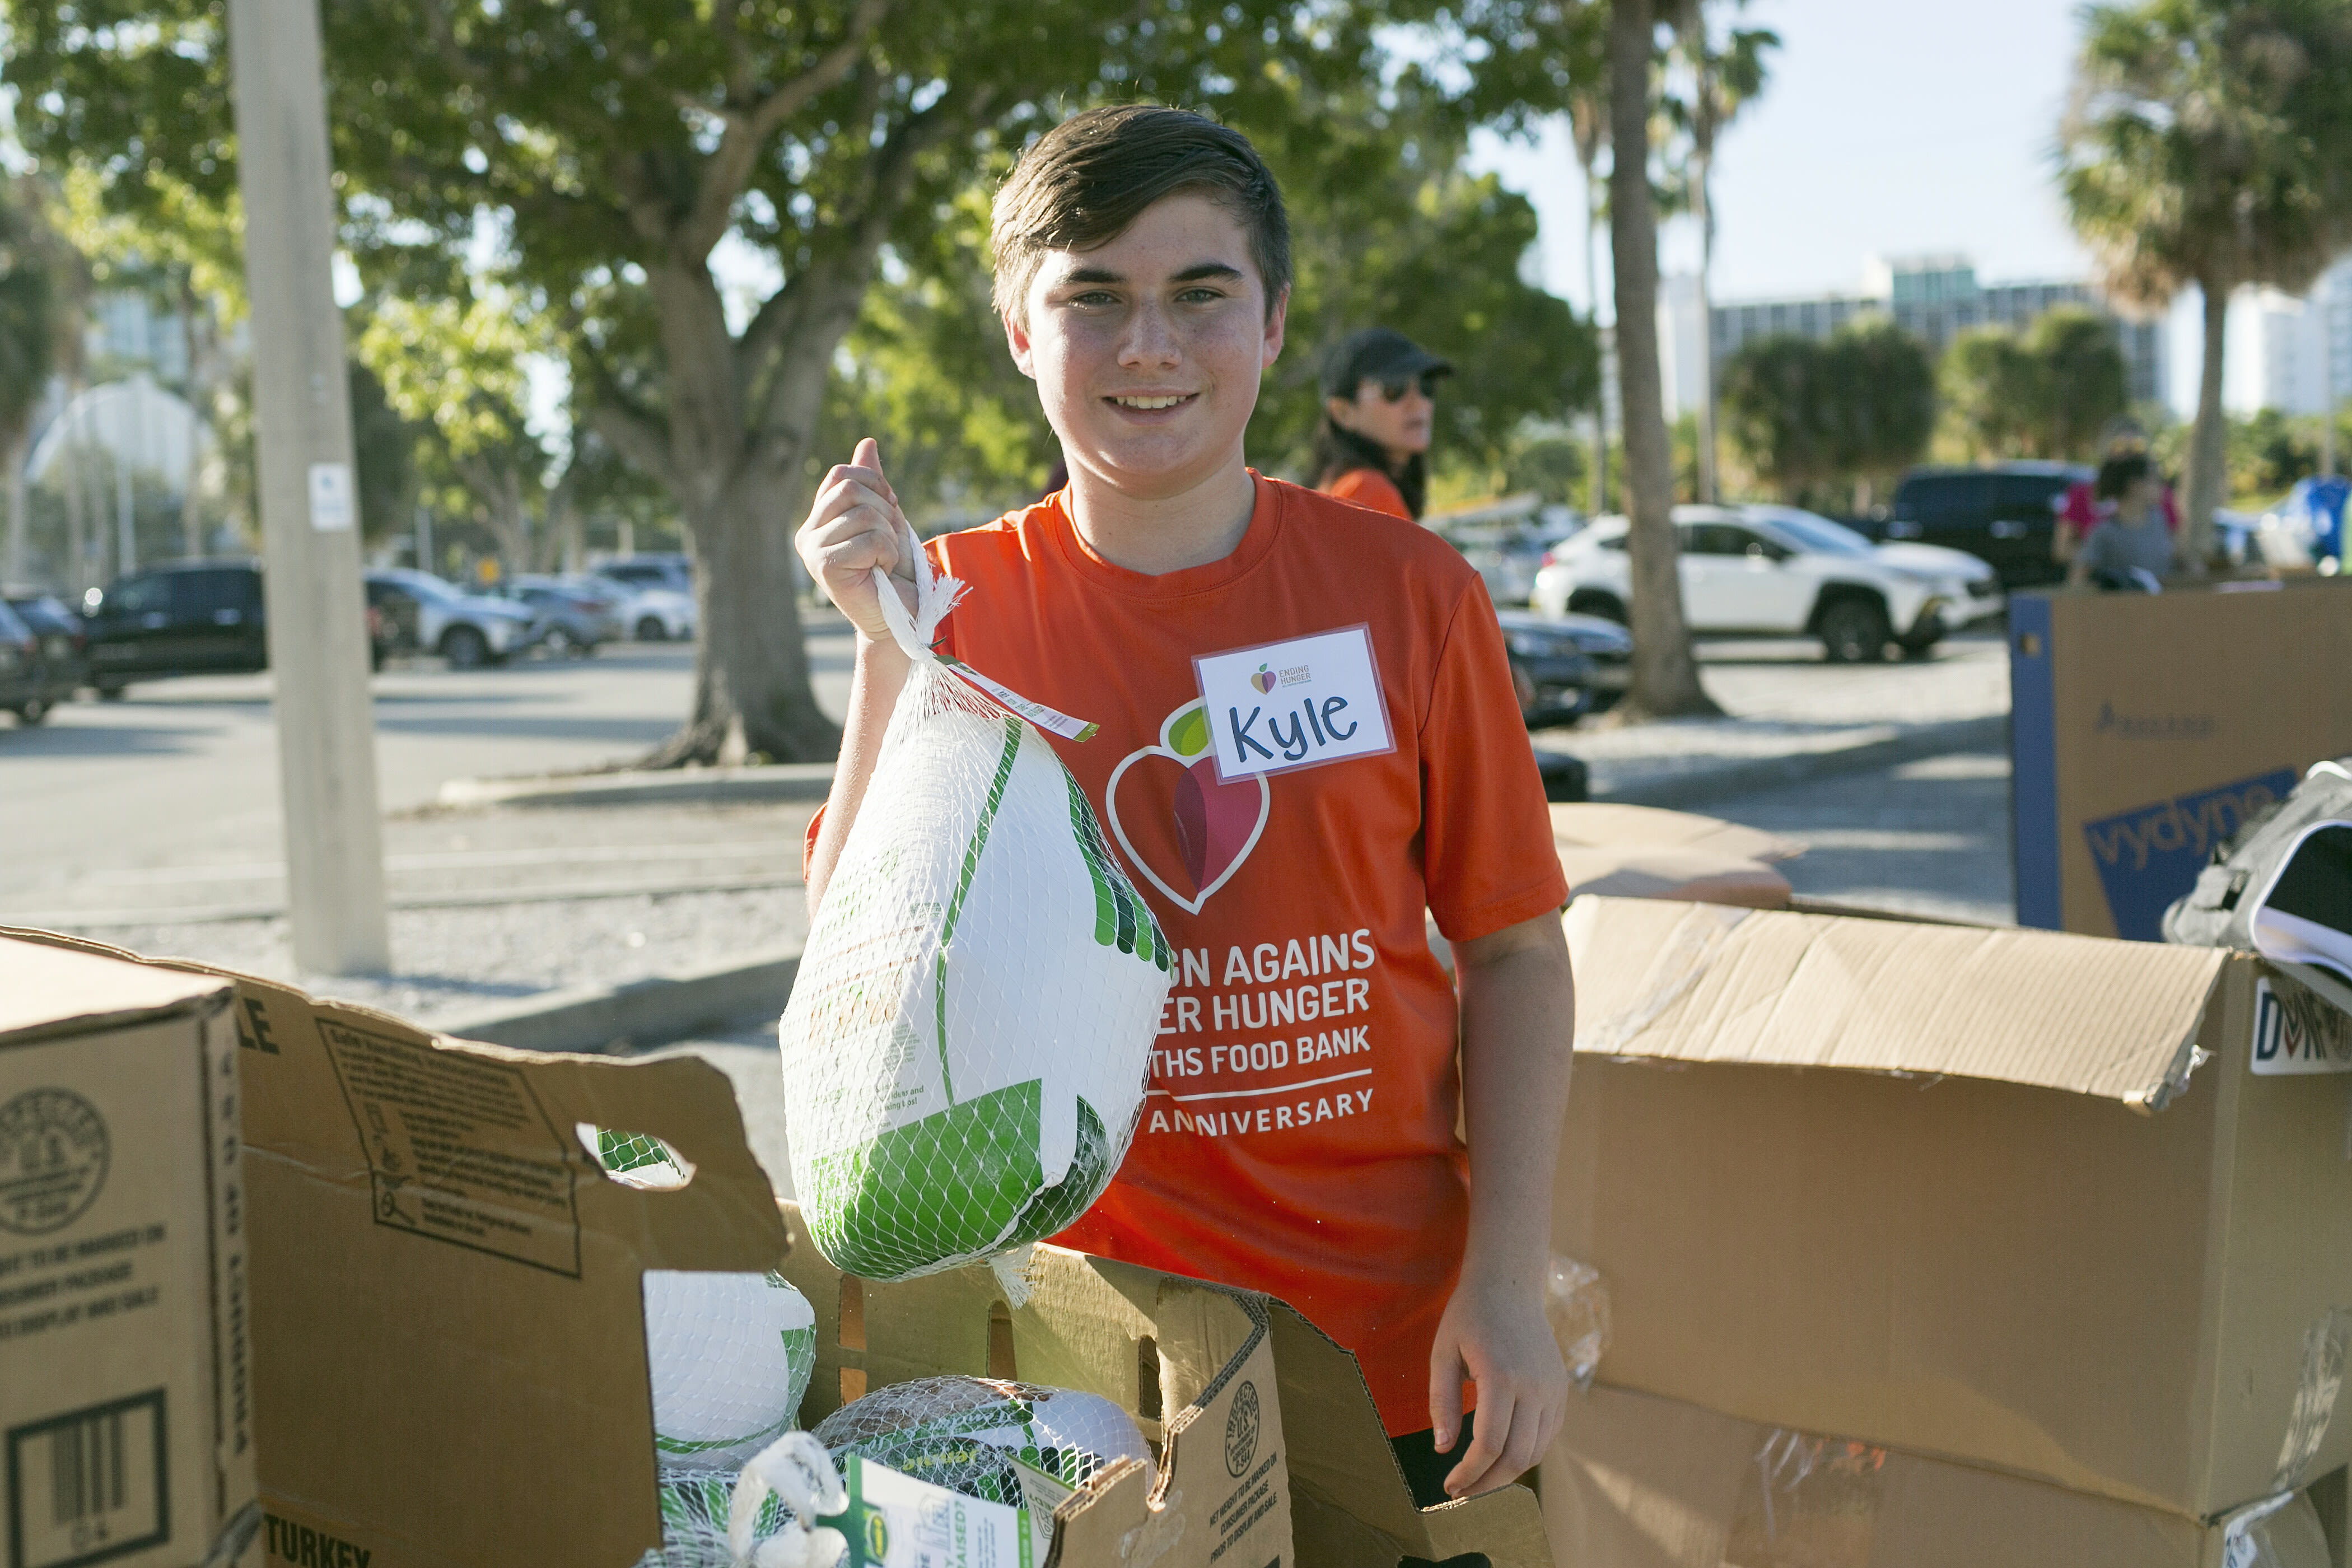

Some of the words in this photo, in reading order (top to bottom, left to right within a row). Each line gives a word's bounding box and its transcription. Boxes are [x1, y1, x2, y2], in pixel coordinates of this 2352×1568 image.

[1278, 665, 1309, 677] ENDING
[1280, 673, 1311, 684] HUNGER
[1229, 696, 1357, 763] Kyle
[1212, 978, 1370, 1032] HUNGER
[1152, 1047, 1203, 1078] THS
[1211, 1040, 1289, 1074] FOOD
[1296, 1024, 1371, 1065] BANK
[910, 1084, 925, 1095] and
[1149, 1088, 1374, 1137] ANNIVERSARY
[1271, 1451, 1277, 1467] ON
[1248, 1479, 1269, 1510] PACKAGE
[1265, 1491, 1277, 1512] SALE
[264, 1513, 371, 1568] TURKEY
